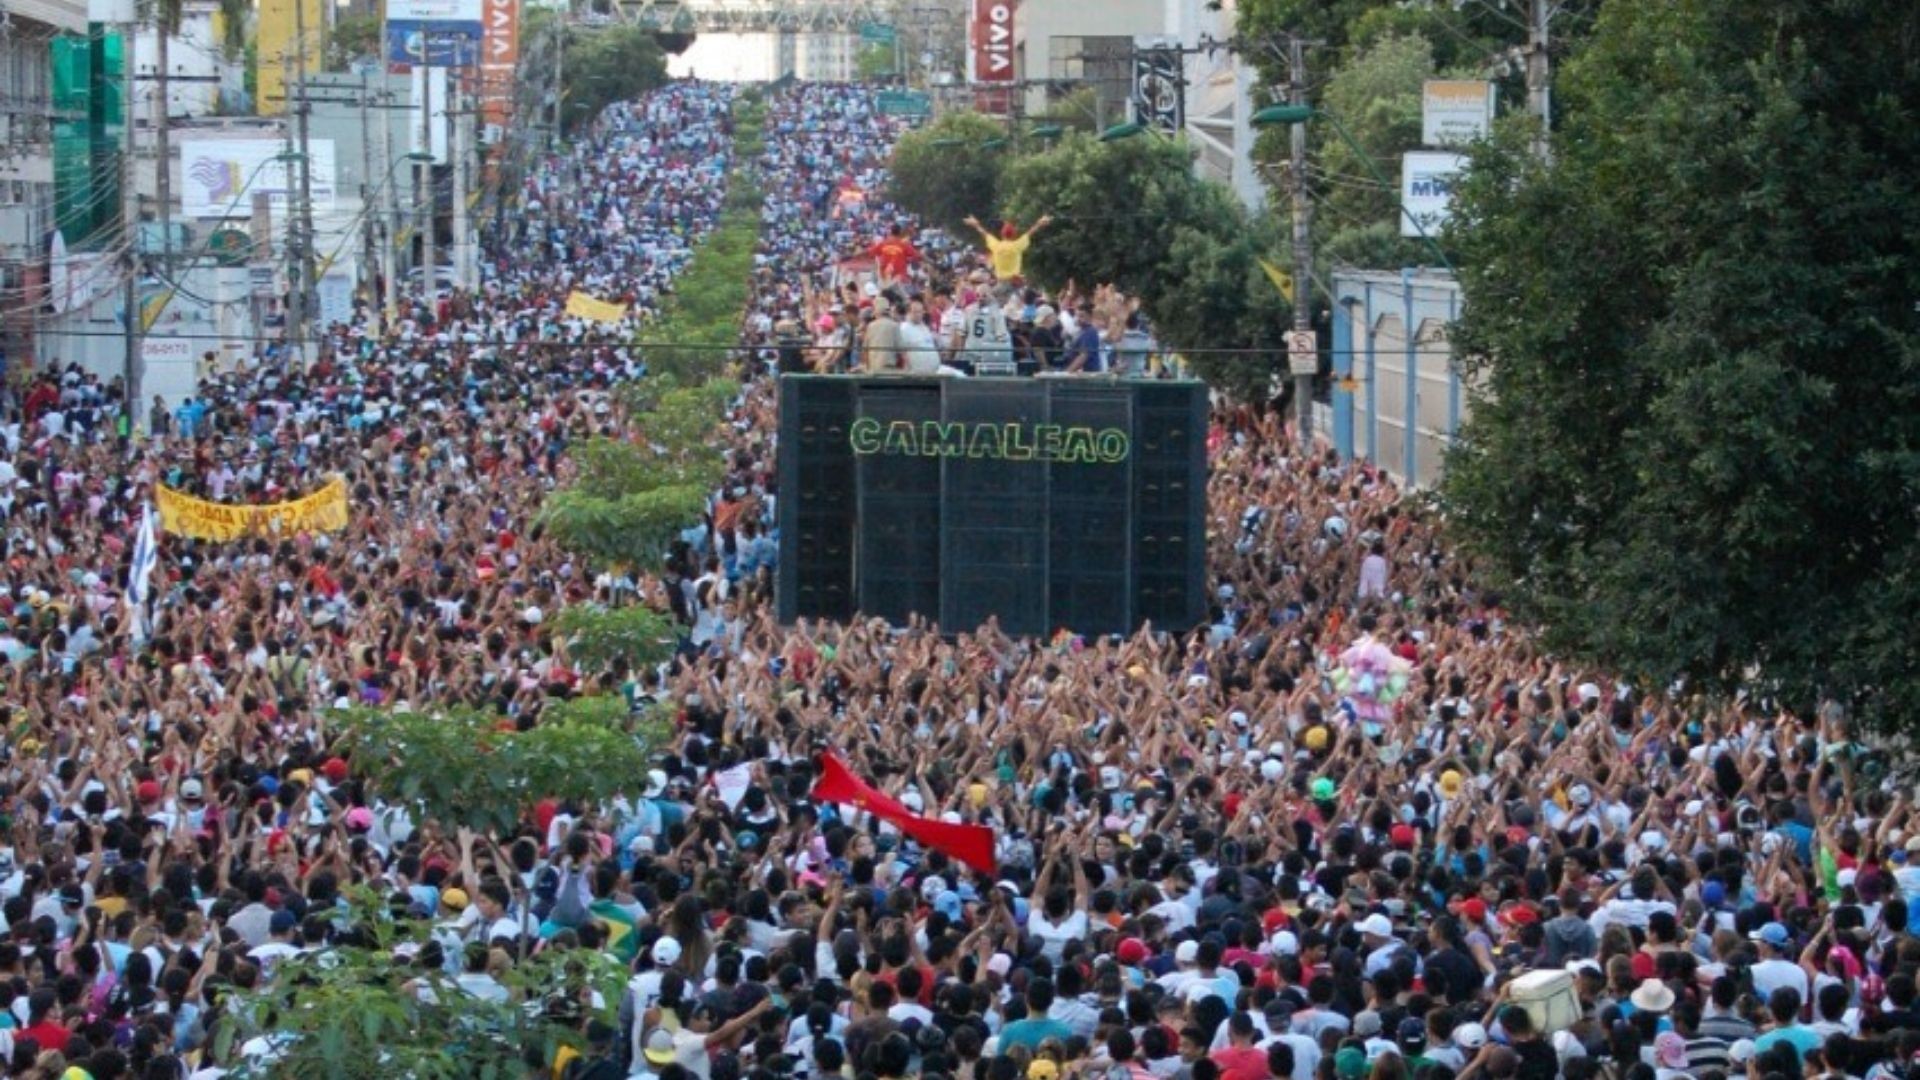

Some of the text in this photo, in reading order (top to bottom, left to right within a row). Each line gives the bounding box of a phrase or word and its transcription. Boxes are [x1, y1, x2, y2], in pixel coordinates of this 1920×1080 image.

[983, 4, 1010, 72] vivo
[972, 318, 986, 339] 6
[850, 416, 1130, 463] CAMALEAO
